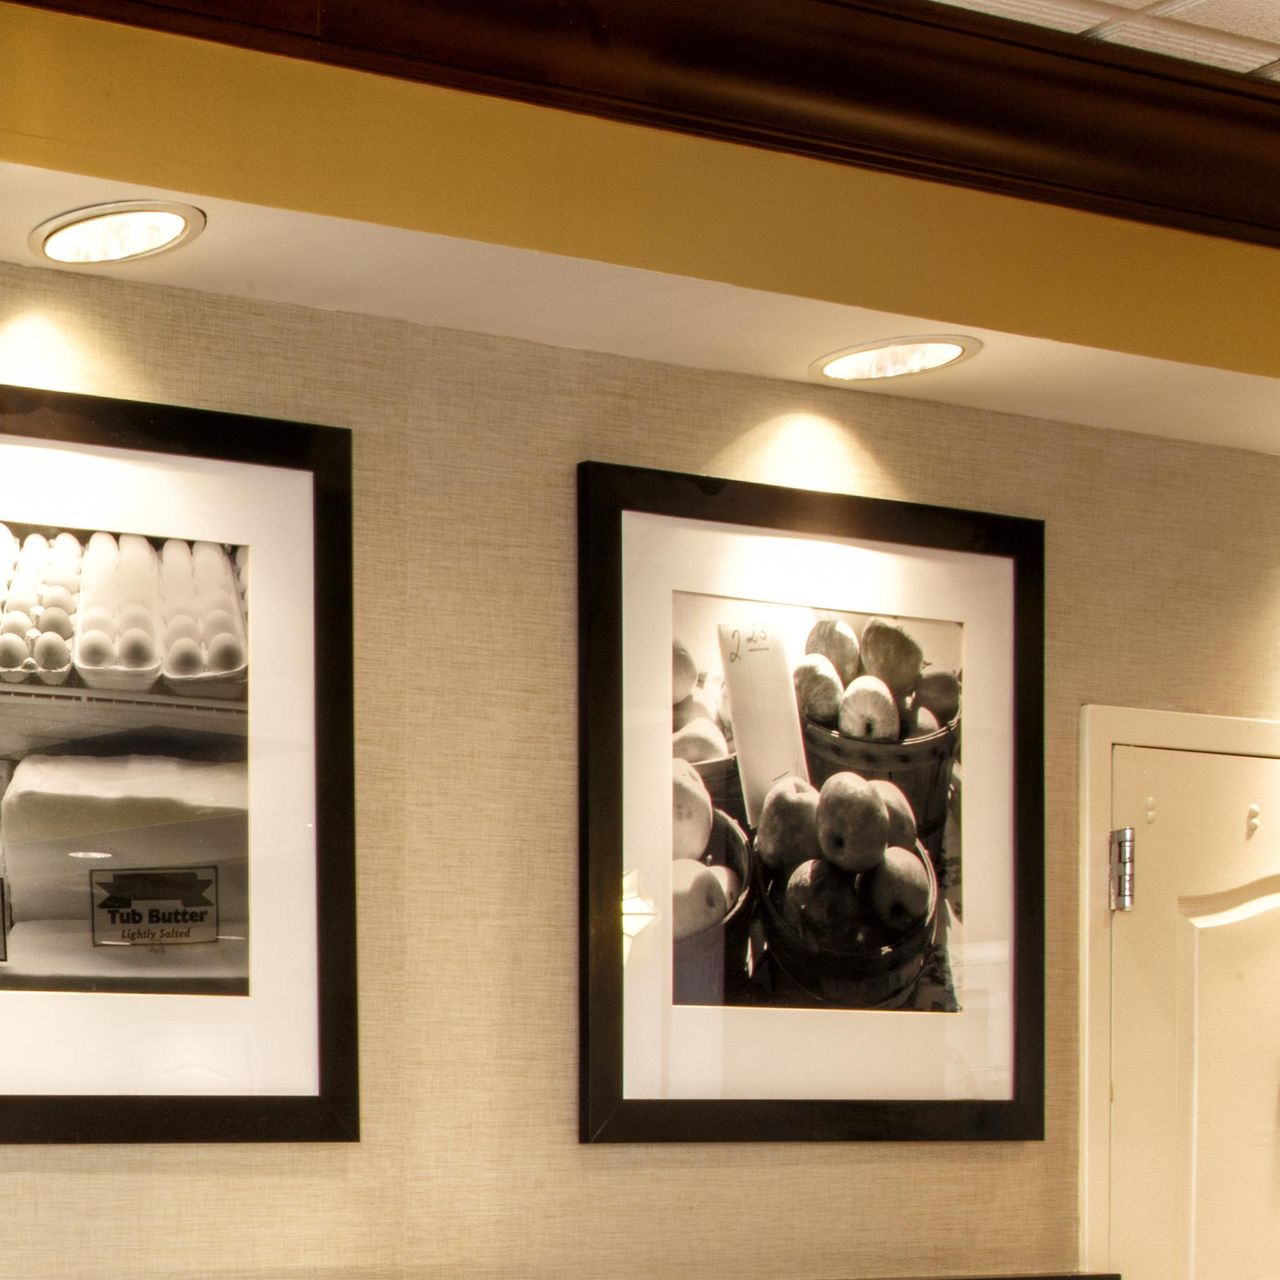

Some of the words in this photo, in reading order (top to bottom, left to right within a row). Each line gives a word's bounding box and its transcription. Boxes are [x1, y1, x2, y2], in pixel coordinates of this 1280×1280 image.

[107, 908, 143, 924] Tub
[148, 908, 208, 924] Butter
[121, 929, 157, 941] Lightly
[160, 928, 191, 938] Salted
